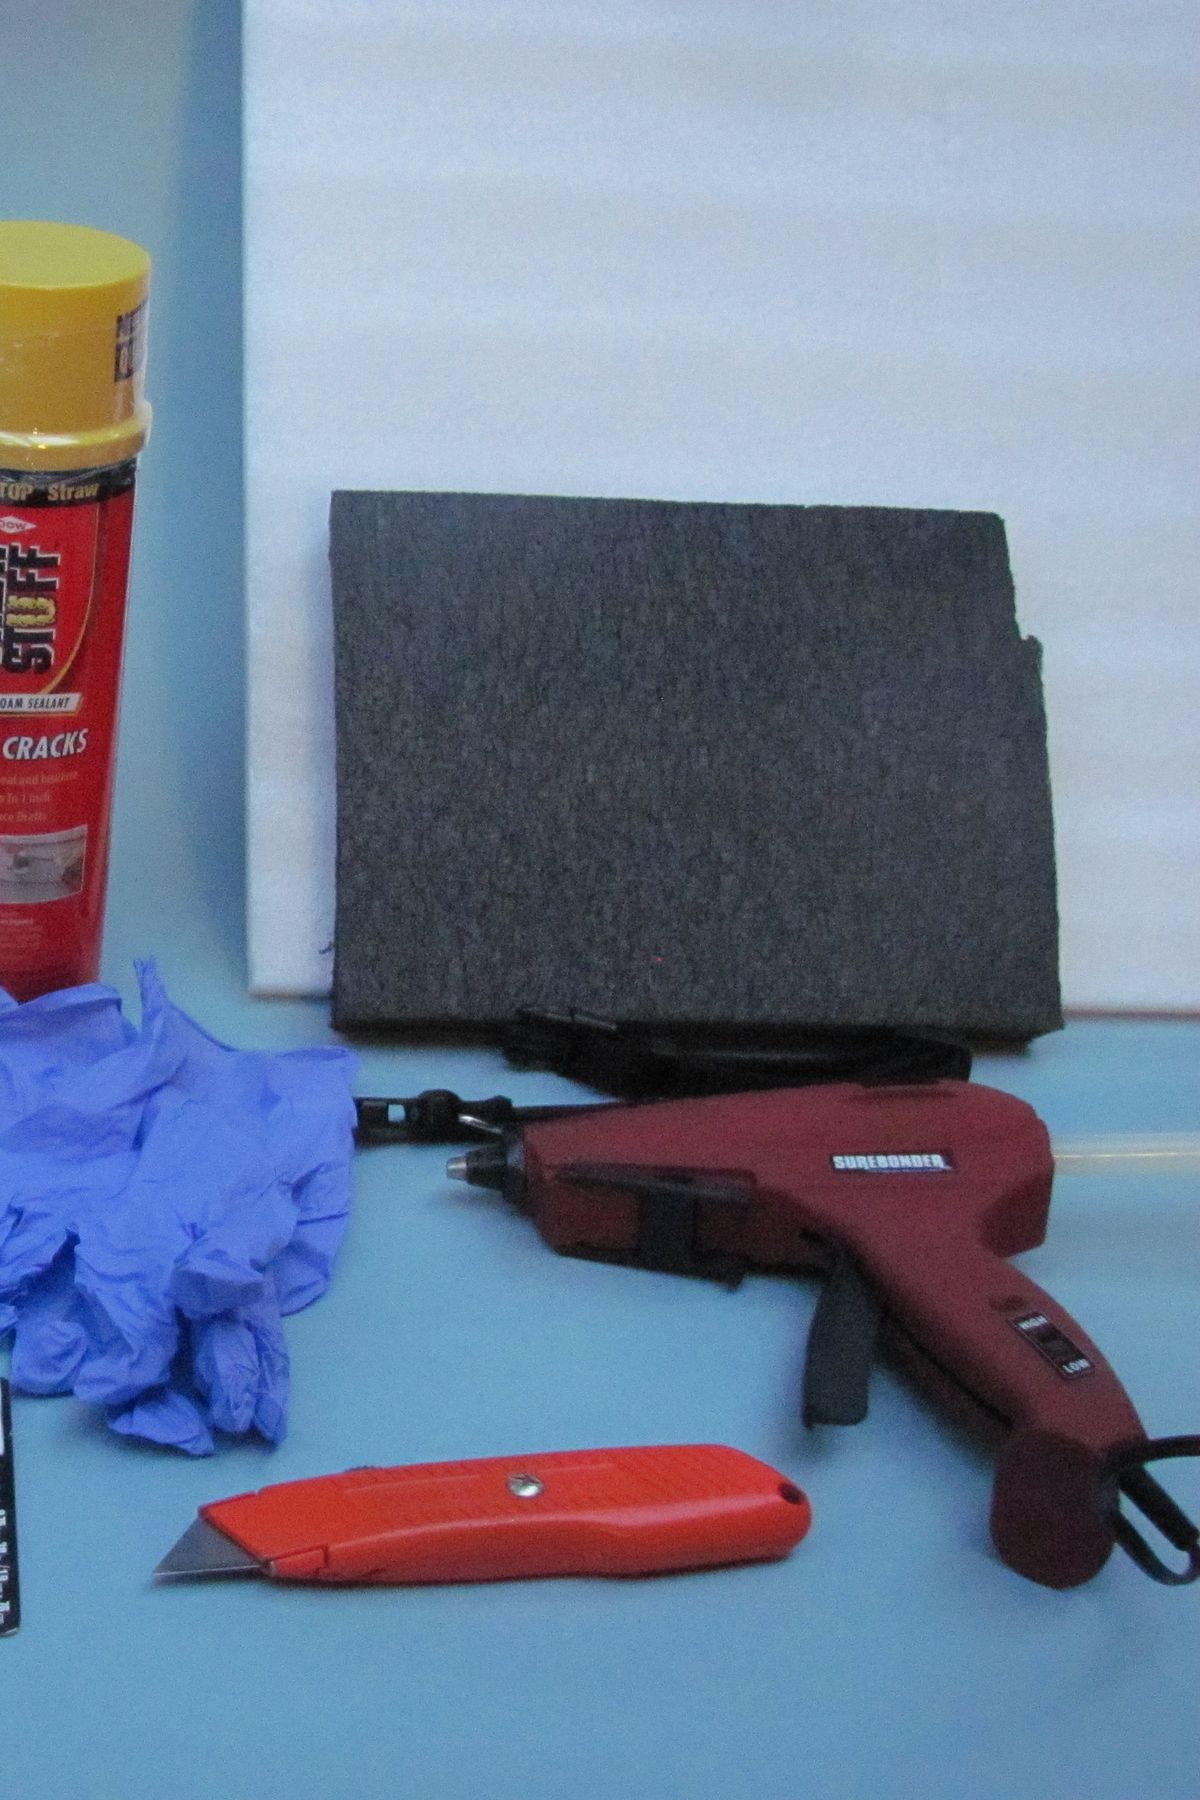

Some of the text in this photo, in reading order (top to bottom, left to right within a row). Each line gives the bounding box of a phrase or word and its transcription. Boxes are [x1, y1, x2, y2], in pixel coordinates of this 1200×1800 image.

[47, 482, 99, 501] Straw
[2, 542, 61, 673] STUFF
[27, 696, 70, 709] SEALANT
[2, 727, 89, 761] CRACKS
[832, 1154, 945, 1170] SUREBONDER
[1017, 1314, 1048, 1331] HIGH
[1062, 1358, 1091, 1375] LOW
